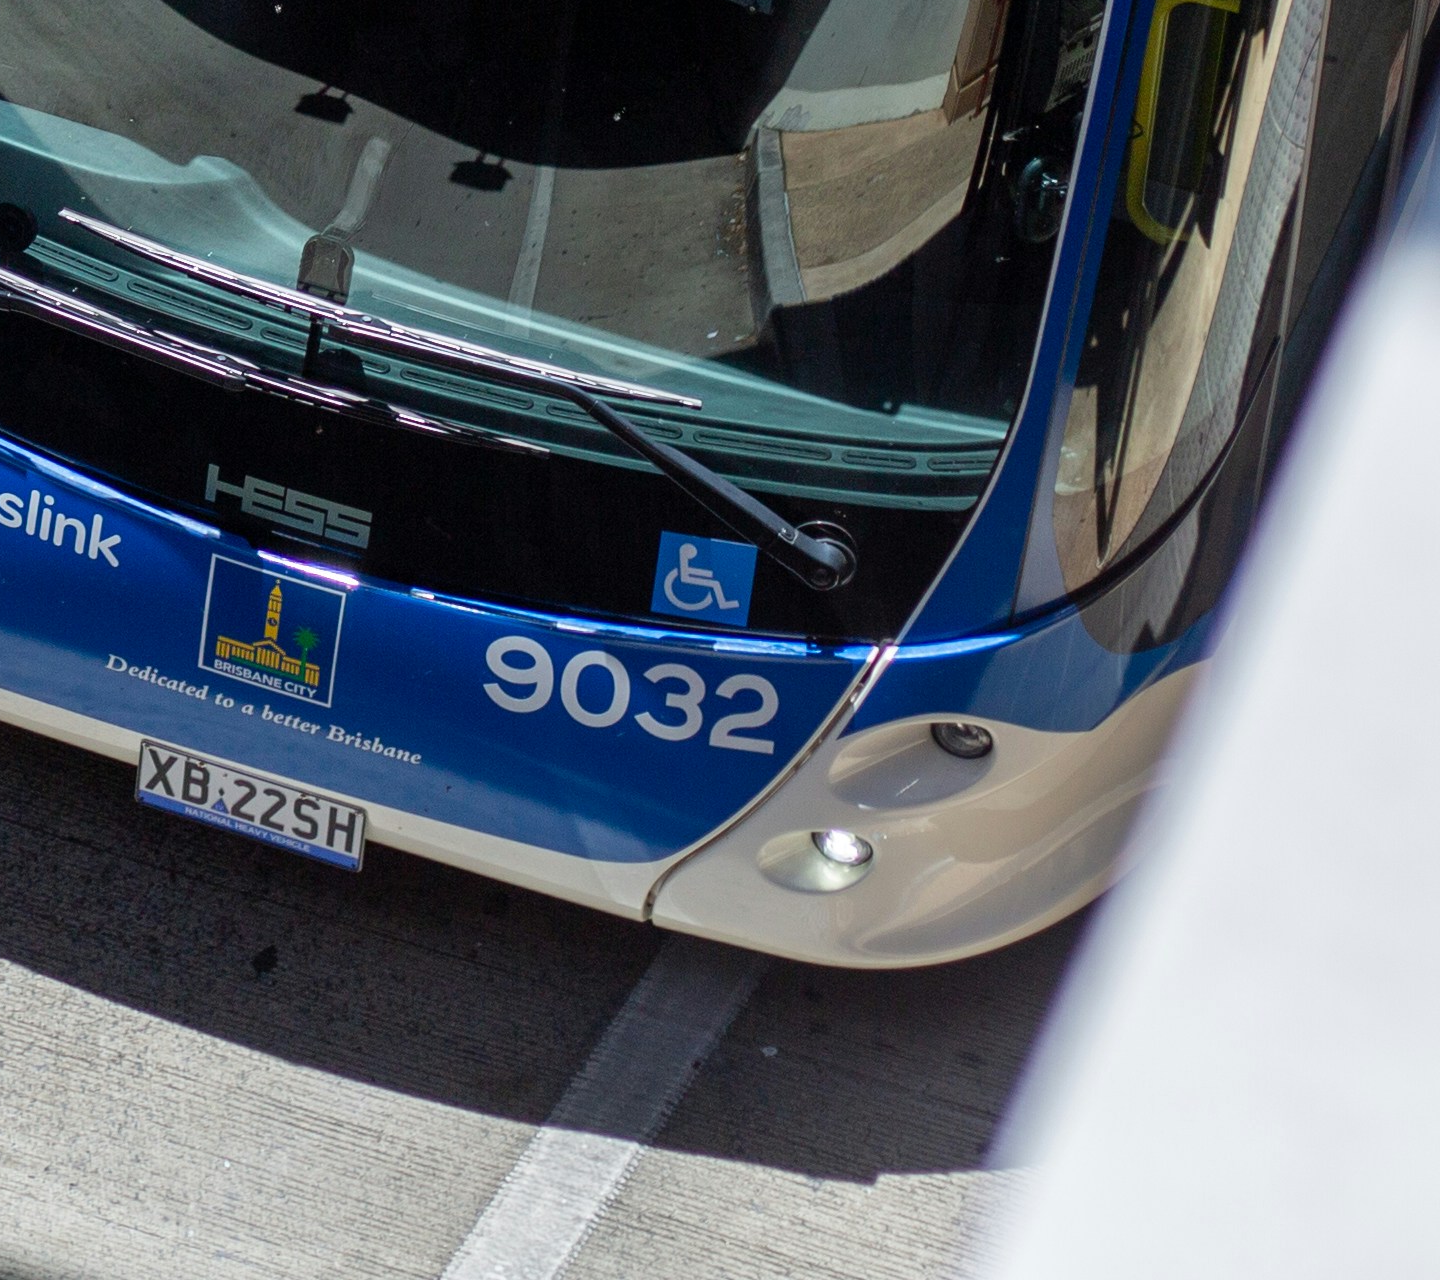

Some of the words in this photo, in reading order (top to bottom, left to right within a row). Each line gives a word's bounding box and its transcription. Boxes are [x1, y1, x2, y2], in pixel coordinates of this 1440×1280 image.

[206, 464, 372, 549] HESS
[105, 654, 208, 701] Dedicated
[215, 692, 235, 709] to
[241, 703, 254, 716] a
[261, 705, 321, 735] better
[325, 724, 423, 765] Brisbane
[213, 659, 282, 690] BRISBANE
[283, 681, 317, 699] CITY
[483, 636, 780, 754] 9032
[184, 806, 233, 828] NATIONAL
[234, 821, 270, 841] HEAVY
[270, 833, 313, 854] VEHICLE
